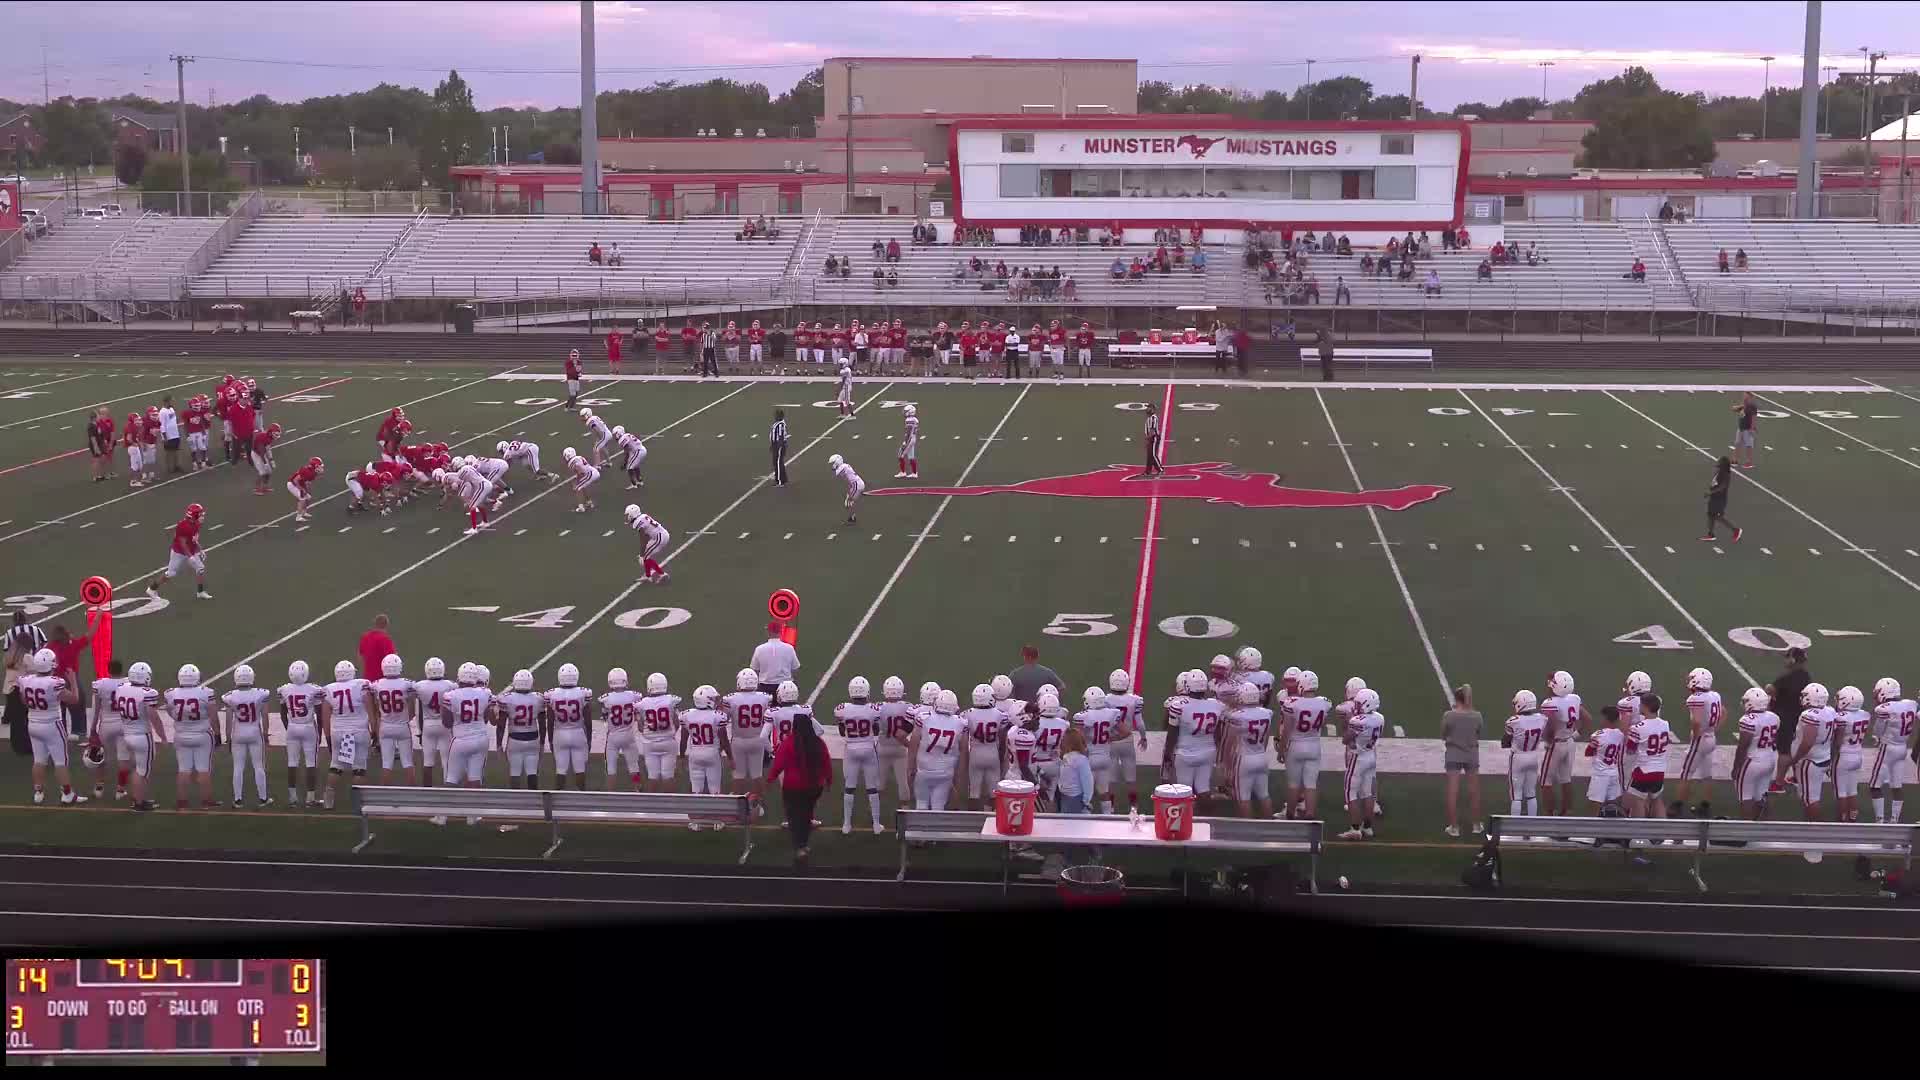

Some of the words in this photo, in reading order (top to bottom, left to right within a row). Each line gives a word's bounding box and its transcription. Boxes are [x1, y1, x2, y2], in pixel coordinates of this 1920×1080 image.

[1084, 138, 1175, 153] MUNSTER
[1227, 139, 1337, 155] MUSTANGS
[24, 688, 48, 710] 66
[174, 699, 200, 721] 73
[288, 695, 306, 718] 15
[333, 689, 354, 715] 71
[237, 703, 256, 722] 31
[460, 699, 479, 723] 61
[514, 705, 533, 726] 21
[555, 700, 580, 723] 53
[611, 703, 633, 726] 83
[645, 707, 670, 731] 99
[738, 704, 763, 728] 69
[1296, 710, 1324, 733] 64
[689, 724, 714, 745] 30
[974, 722, 998, 743] 46
[1092, 721, 1110, 744] 16
[1192, 712, 1217, 735] 72
[1248, 719, 1269, 744] 57
[1900, 711, 1914, 737] 12
[927, 728, 955, 754] 77
[1036, 728, 1062, 750] 47
[1523, 728, 1541, 752] 17
[1647, 732, 1669, 755] 92
[1009, 800, 1021, 814] G
[1167, 805, 1180, 818] G
